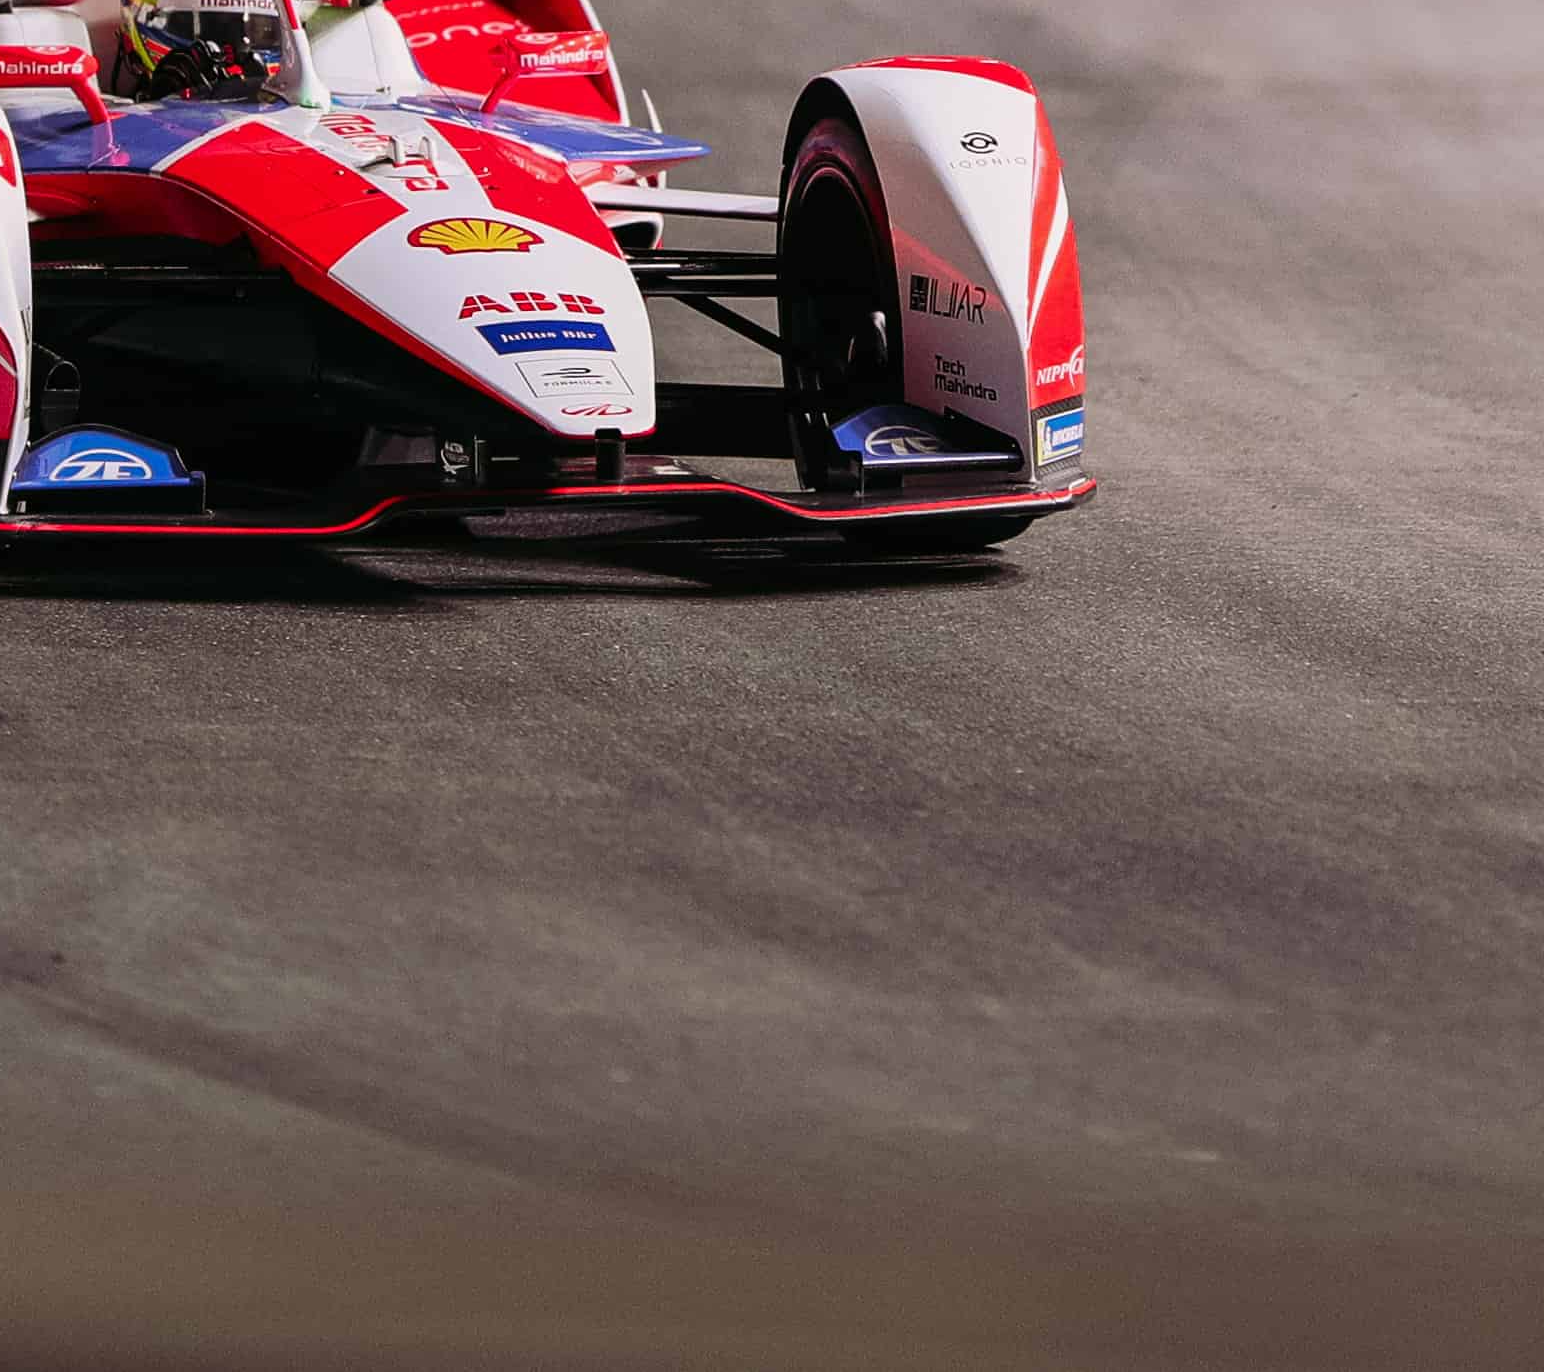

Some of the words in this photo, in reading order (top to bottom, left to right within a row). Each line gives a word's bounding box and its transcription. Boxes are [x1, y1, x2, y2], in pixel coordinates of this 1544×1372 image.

[519, 48, 604, 68] Mahindra
[459, 292, 606, 319] ABB
[500, 331, 557, 343] Julius
[935, 354, 966, 376] Tech
[935, 374, 998, 401] Mahindra
